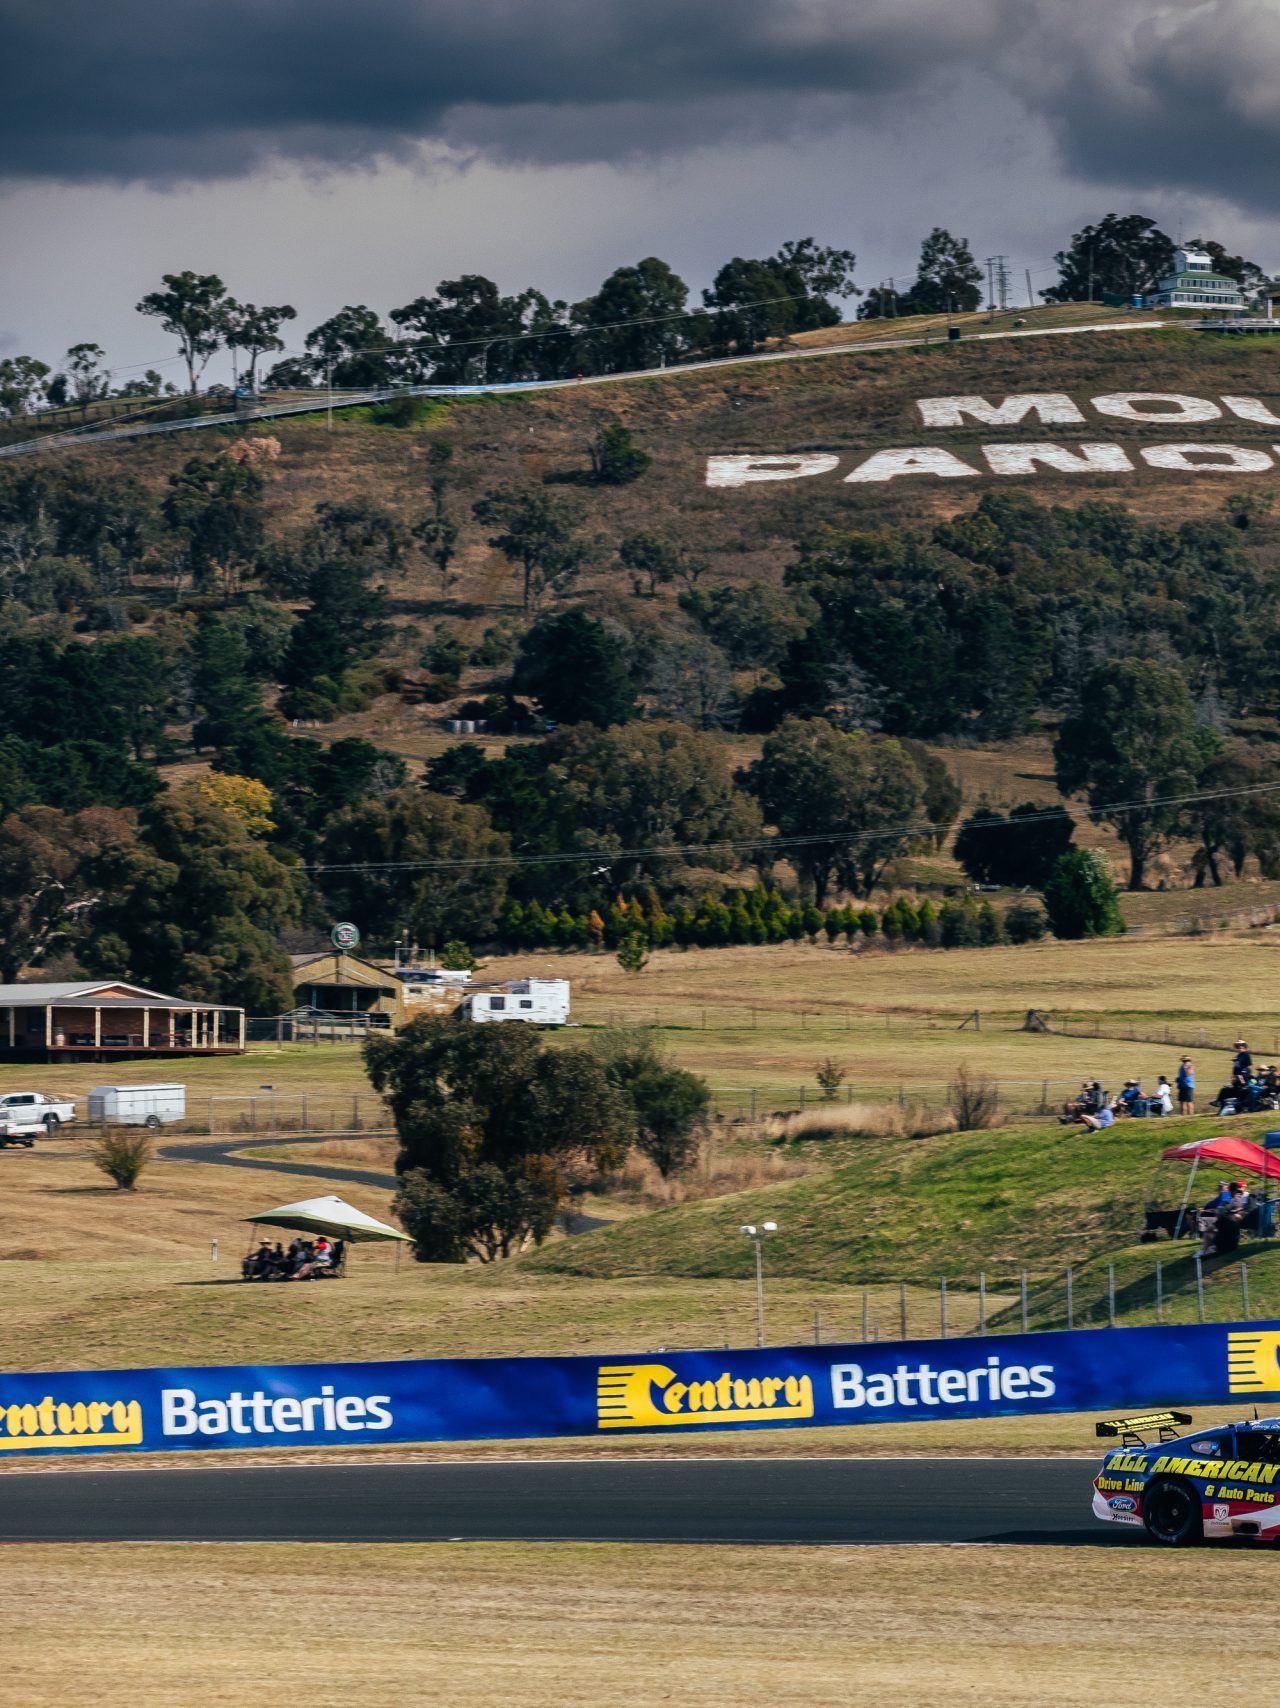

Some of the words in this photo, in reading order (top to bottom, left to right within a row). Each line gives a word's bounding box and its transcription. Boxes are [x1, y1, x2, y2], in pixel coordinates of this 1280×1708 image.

[597, 1364, 814, 1428] Century
[831, 1356, 1056, 1409] Batteries
[0, 1396, 143, 1449] ntury
[161, 1386, 394, 1436] Batteries
[1106, 1455, 1149, 1473] ALL
[1098, 1477, 1122, 1491] Drive
[1125, 1478, 1145, 1492] Line
[1205, 1485, 1214, 1496] &
[1218, 1486, 1244, 1500] Auto
[1246, 1490, 1275, 1504] Parts
[1112, 1499, 1132, 1509] Ford
